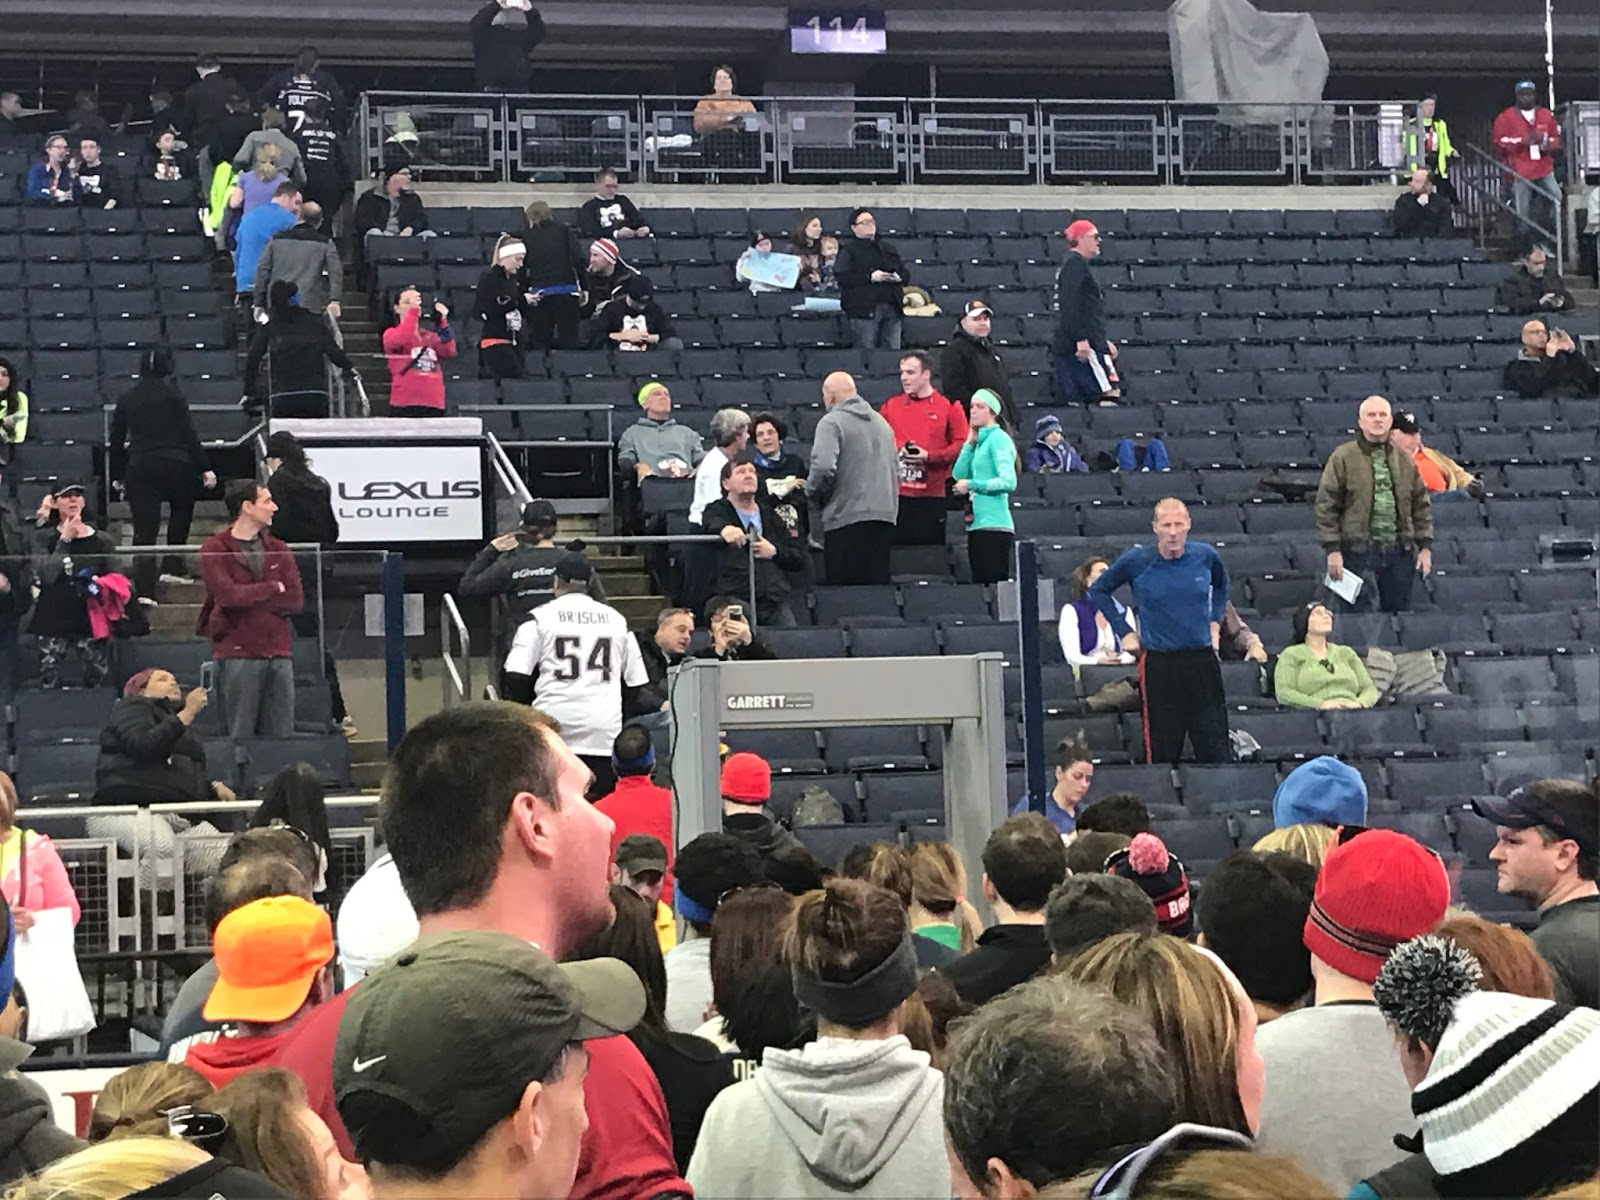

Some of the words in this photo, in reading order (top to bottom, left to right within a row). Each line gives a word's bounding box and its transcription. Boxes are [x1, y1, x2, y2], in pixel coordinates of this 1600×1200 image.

[807, 16, 870, 44] 114
[338, 481, 481, 500] LEXUS
[339, 506, 449, 519] LOUNGE
[554, 635, 612, 683] 54
[727, 695, 786, 709] GARRETT
